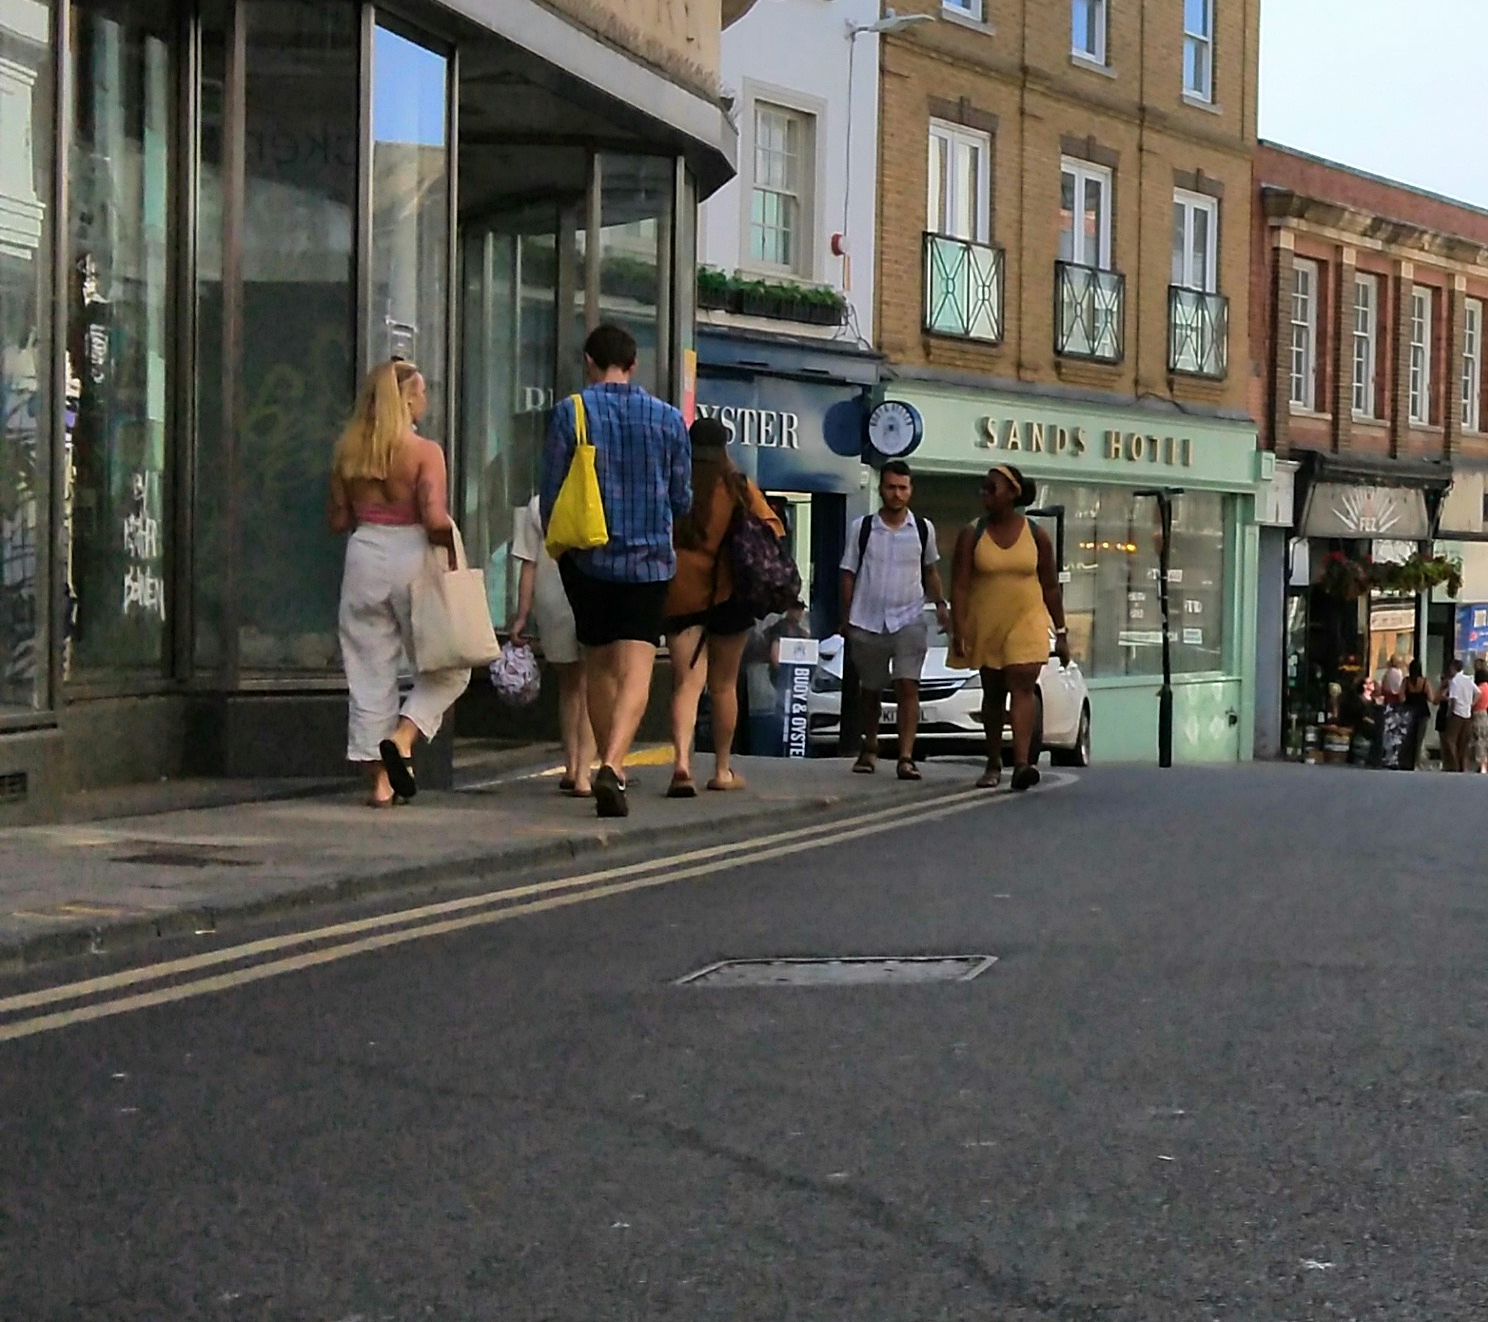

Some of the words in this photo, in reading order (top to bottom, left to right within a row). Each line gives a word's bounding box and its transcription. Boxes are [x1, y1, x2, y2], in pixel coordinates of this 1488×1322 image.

[696, 403, 800, 449] YSTER
[981, 416, 1087, 456] SANDS
[793, 667, 810, 701] BUOY
[792, 703, 807, 714] &
[789, 717, 807, 759] OYSTE
